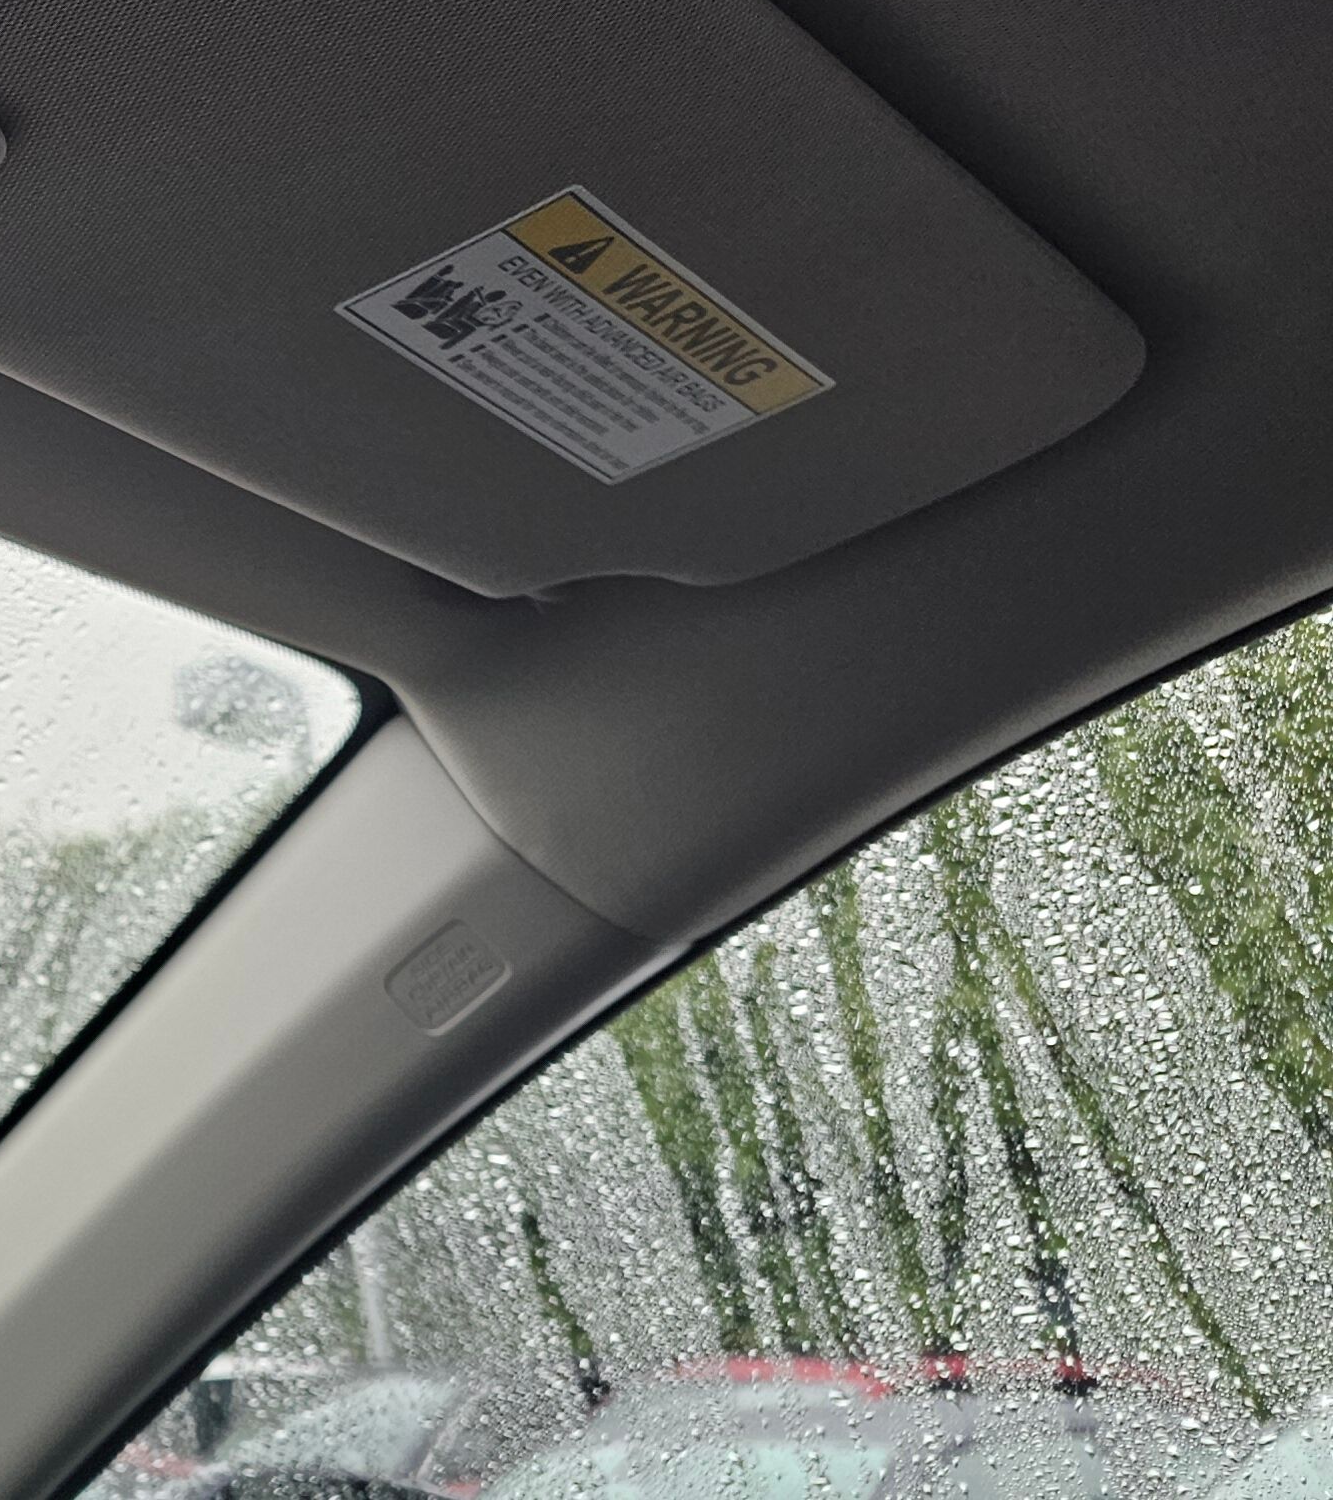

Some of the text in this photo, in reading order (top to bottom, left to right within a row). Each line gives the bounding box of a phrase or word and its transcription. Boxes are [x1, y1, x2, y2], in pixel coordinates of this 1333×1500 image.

[497, 255, 554, 292] EVEN
[541, 285, 594, 321] WITH
[582, 314, 666, 371] ADVANCED
[600, 263, 777, 387] WARNING
